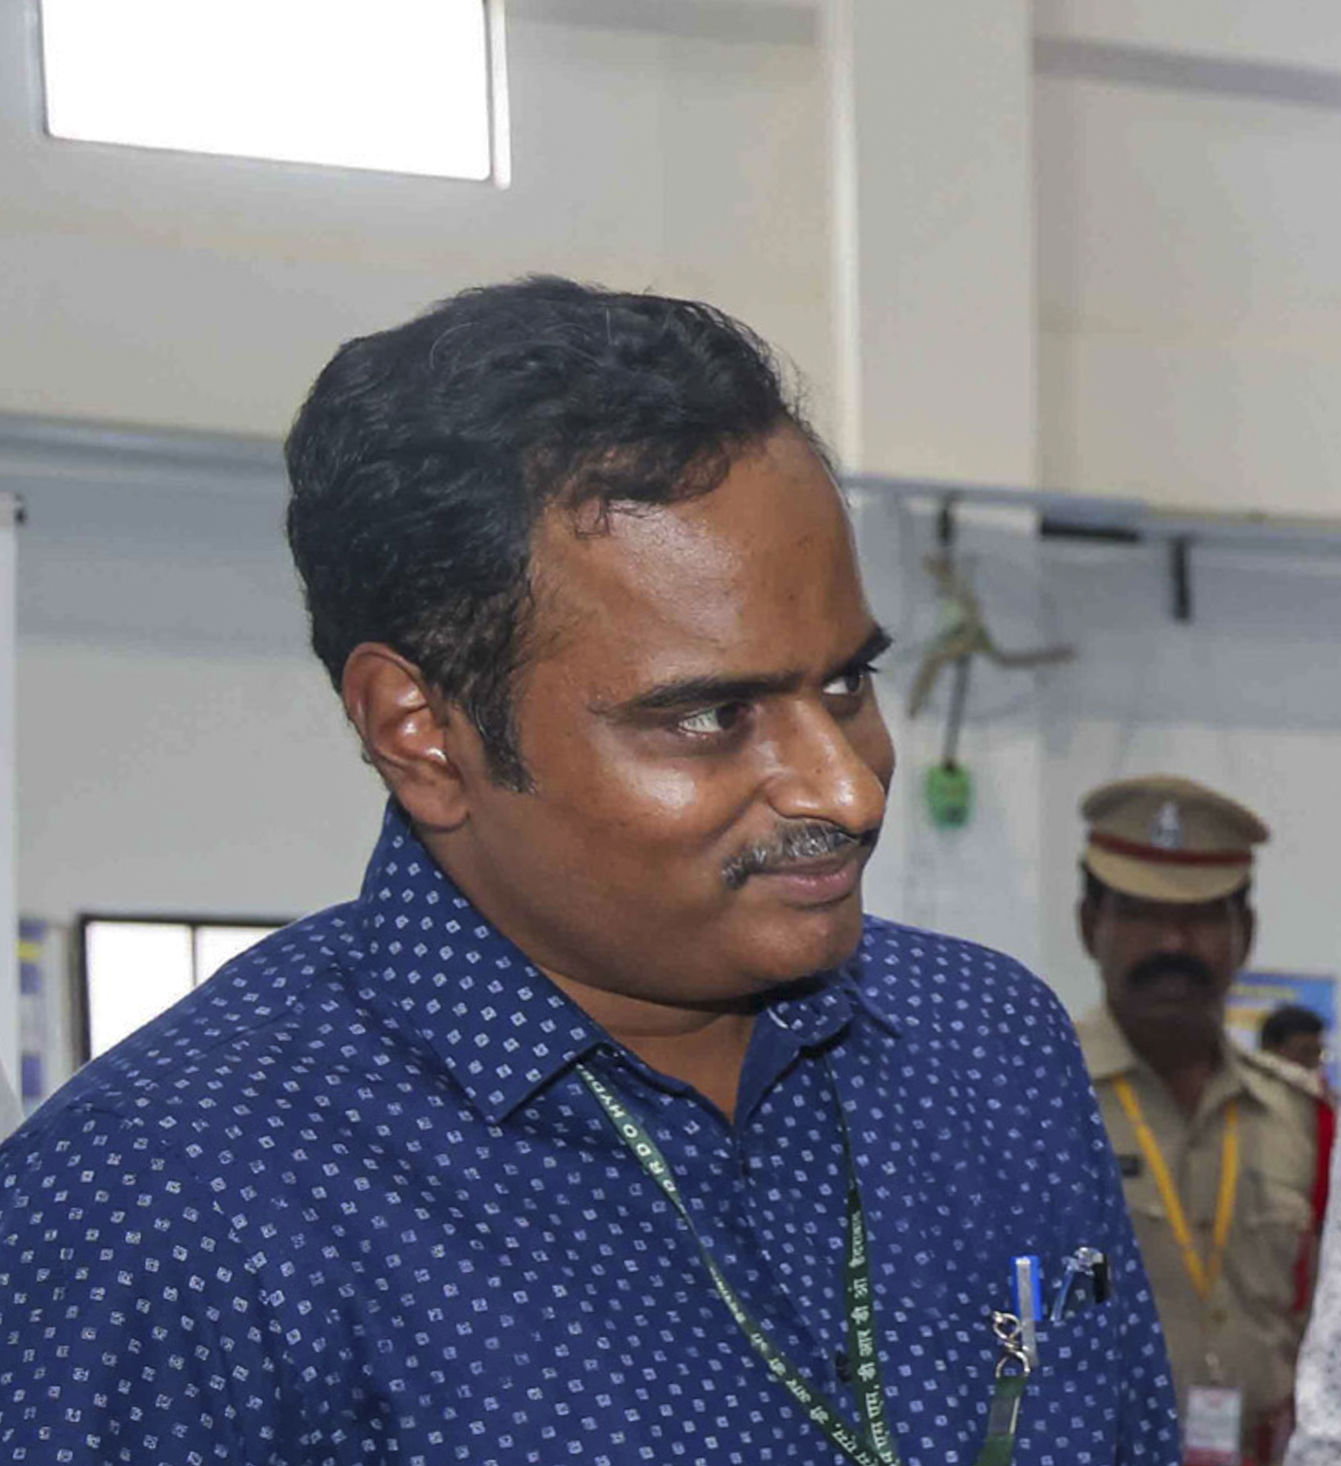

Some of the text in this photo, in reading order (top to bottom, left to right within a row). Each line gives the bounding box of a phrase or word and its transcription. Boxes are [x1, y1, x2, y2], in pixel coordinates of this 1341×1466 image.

[622, 1123, 638, 1138] O
[636, 1142, 652, 1157] D
[649, 1160, 665, 1174] R
[662, 1179, 676, 1192] D
